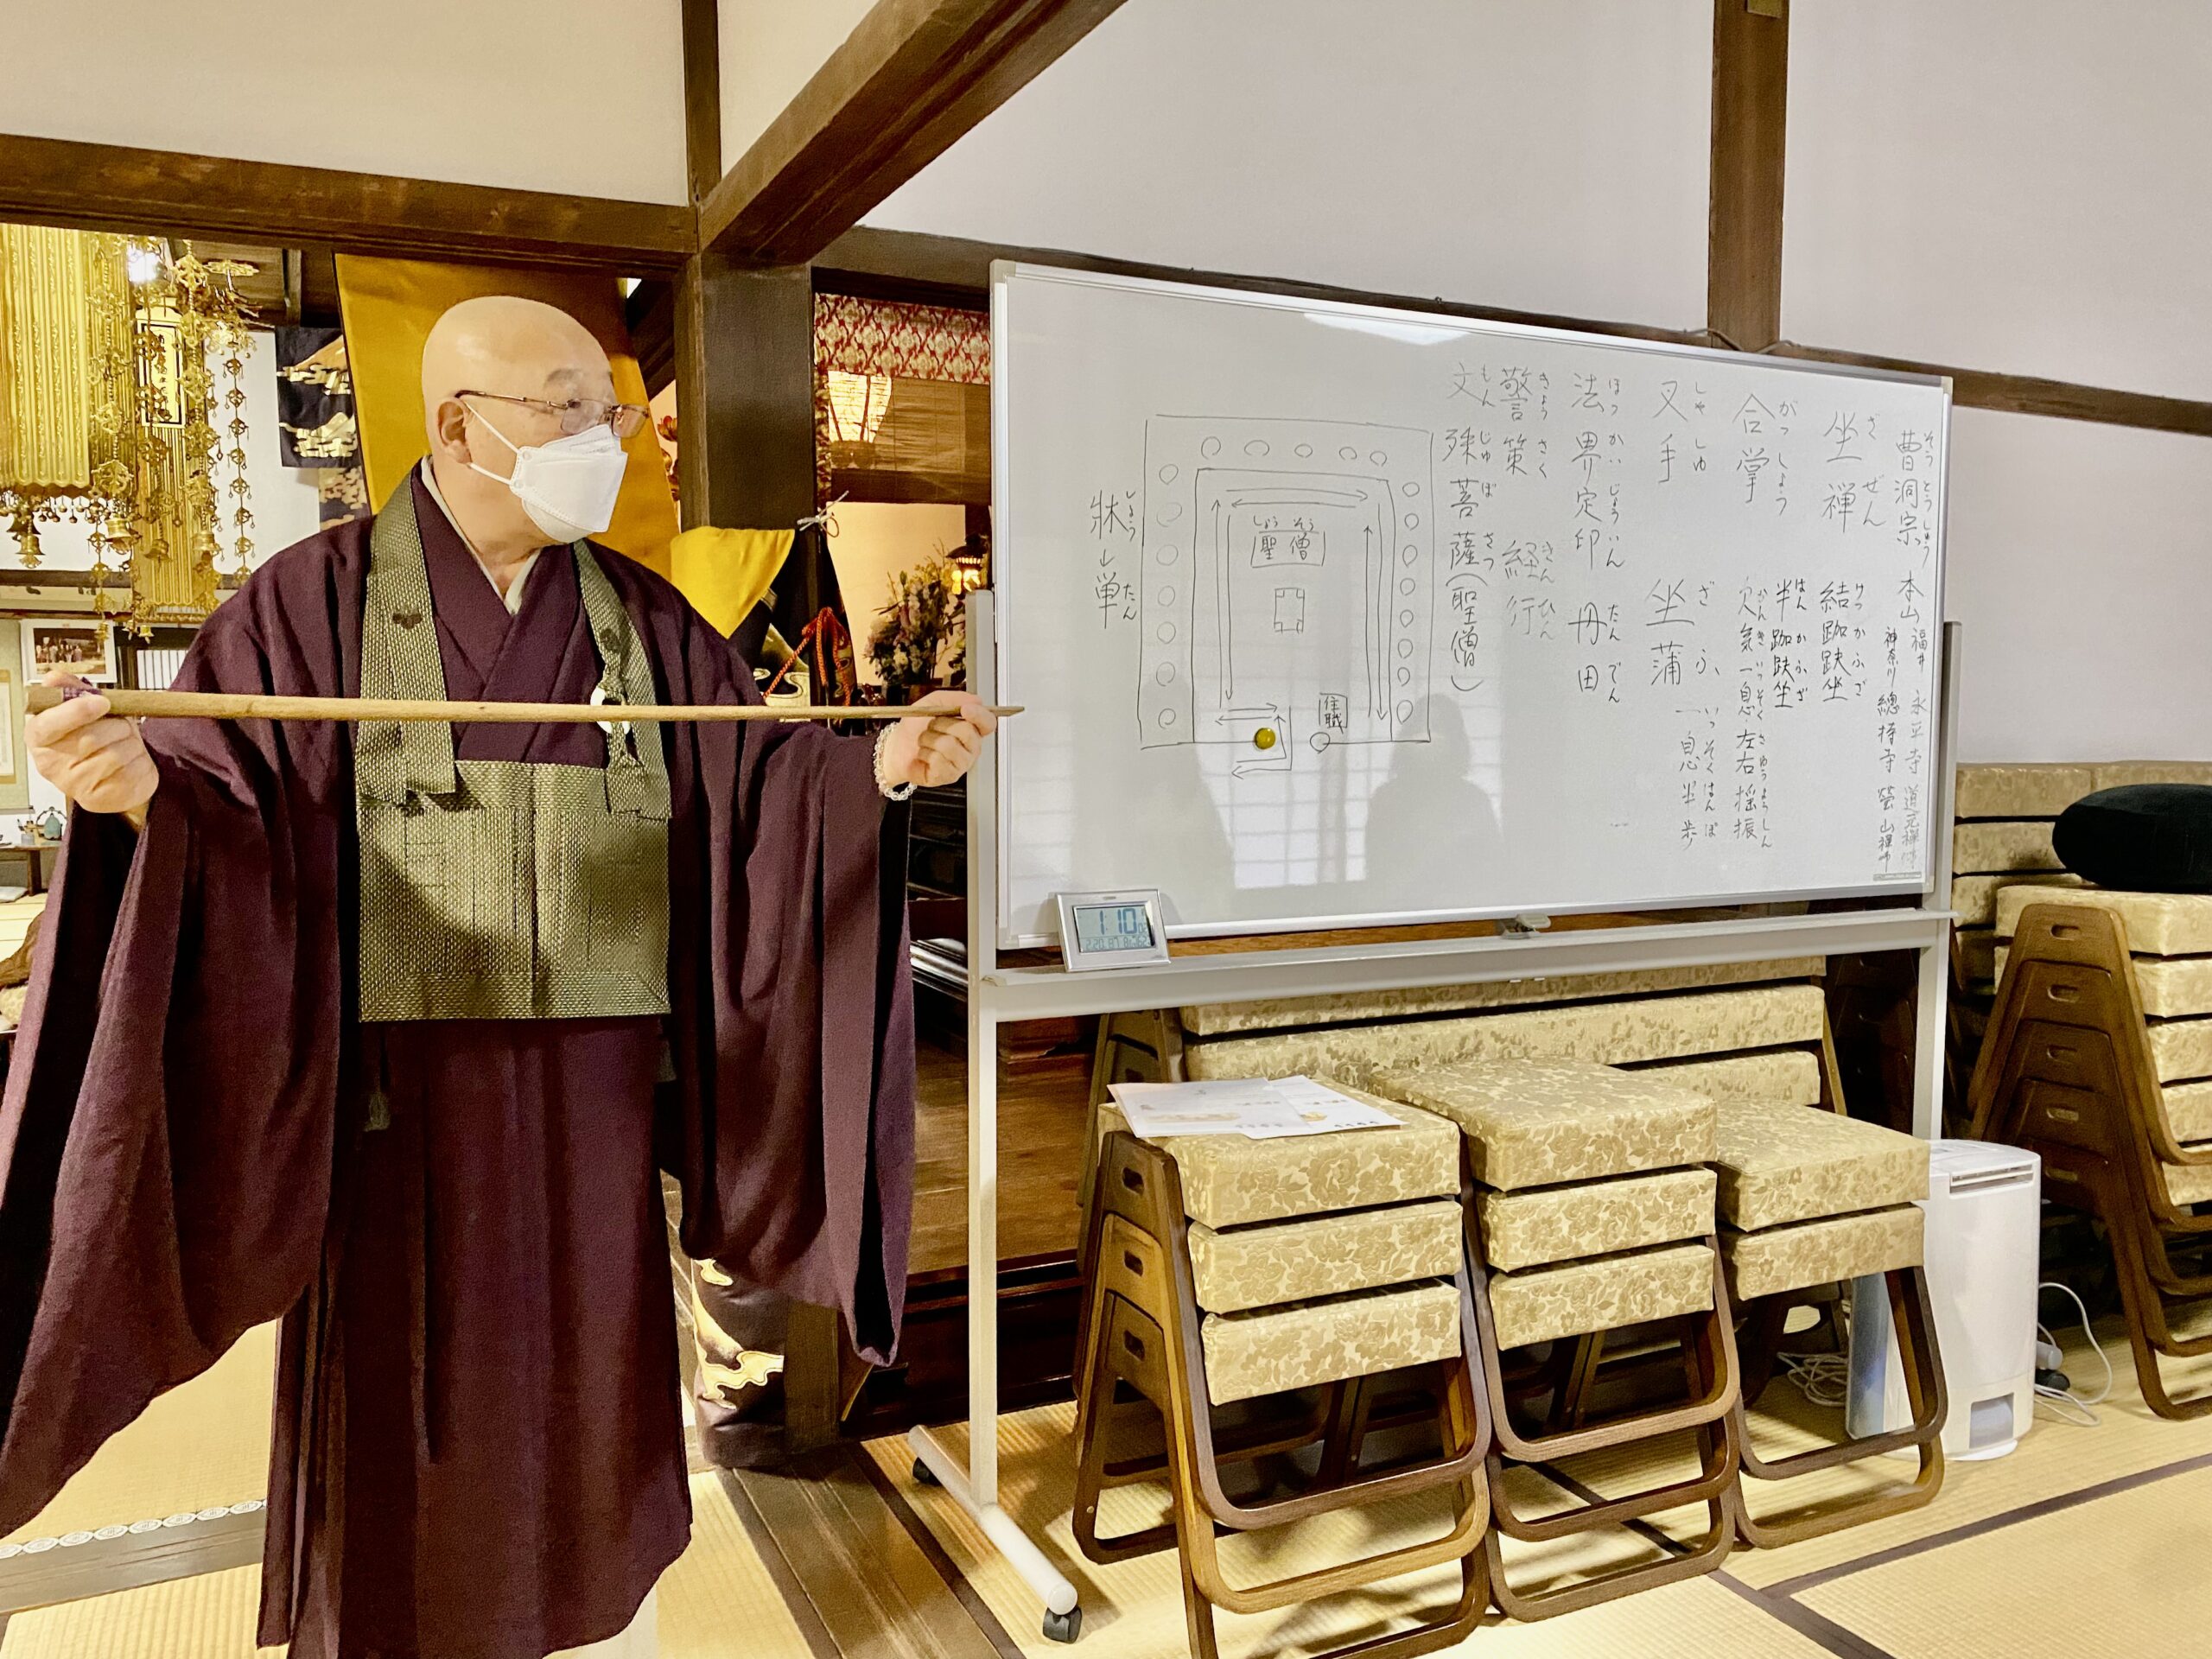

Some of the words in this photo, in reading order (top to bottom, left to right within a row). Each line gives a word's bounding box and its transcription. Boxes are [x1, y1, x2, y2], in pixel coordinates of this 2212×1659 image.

[1499, 365, 1533, 475] 警策
[1571, 372, 1605, 570] 法界定印
[1732, 393, 1776, 504] 合掌
[1821, 410, 1863, 534] 坐禅
[1894, 429, 1922, 546] 曹洞宗
[1260, 534, 1312, 561] 聖僧
[1501, 539, 1537, 635] 経行
[1897, 569, 1924, 623] 本山
[1567, 601, 1608, 693] 丹田
[1645, 578, 1695, 686] 坐蒲
[1770, 577, 1796, 709] 半跏趺坐
[1819, 581, 1852, 702] 結跏趺坐
[1883, 626, 1899, 688] 神奈川
[1910, 626, 1928, 673] 福井
[1324, 696, 1344, 734] 住職
[1904, 689, 1928, 775] 永平寺
